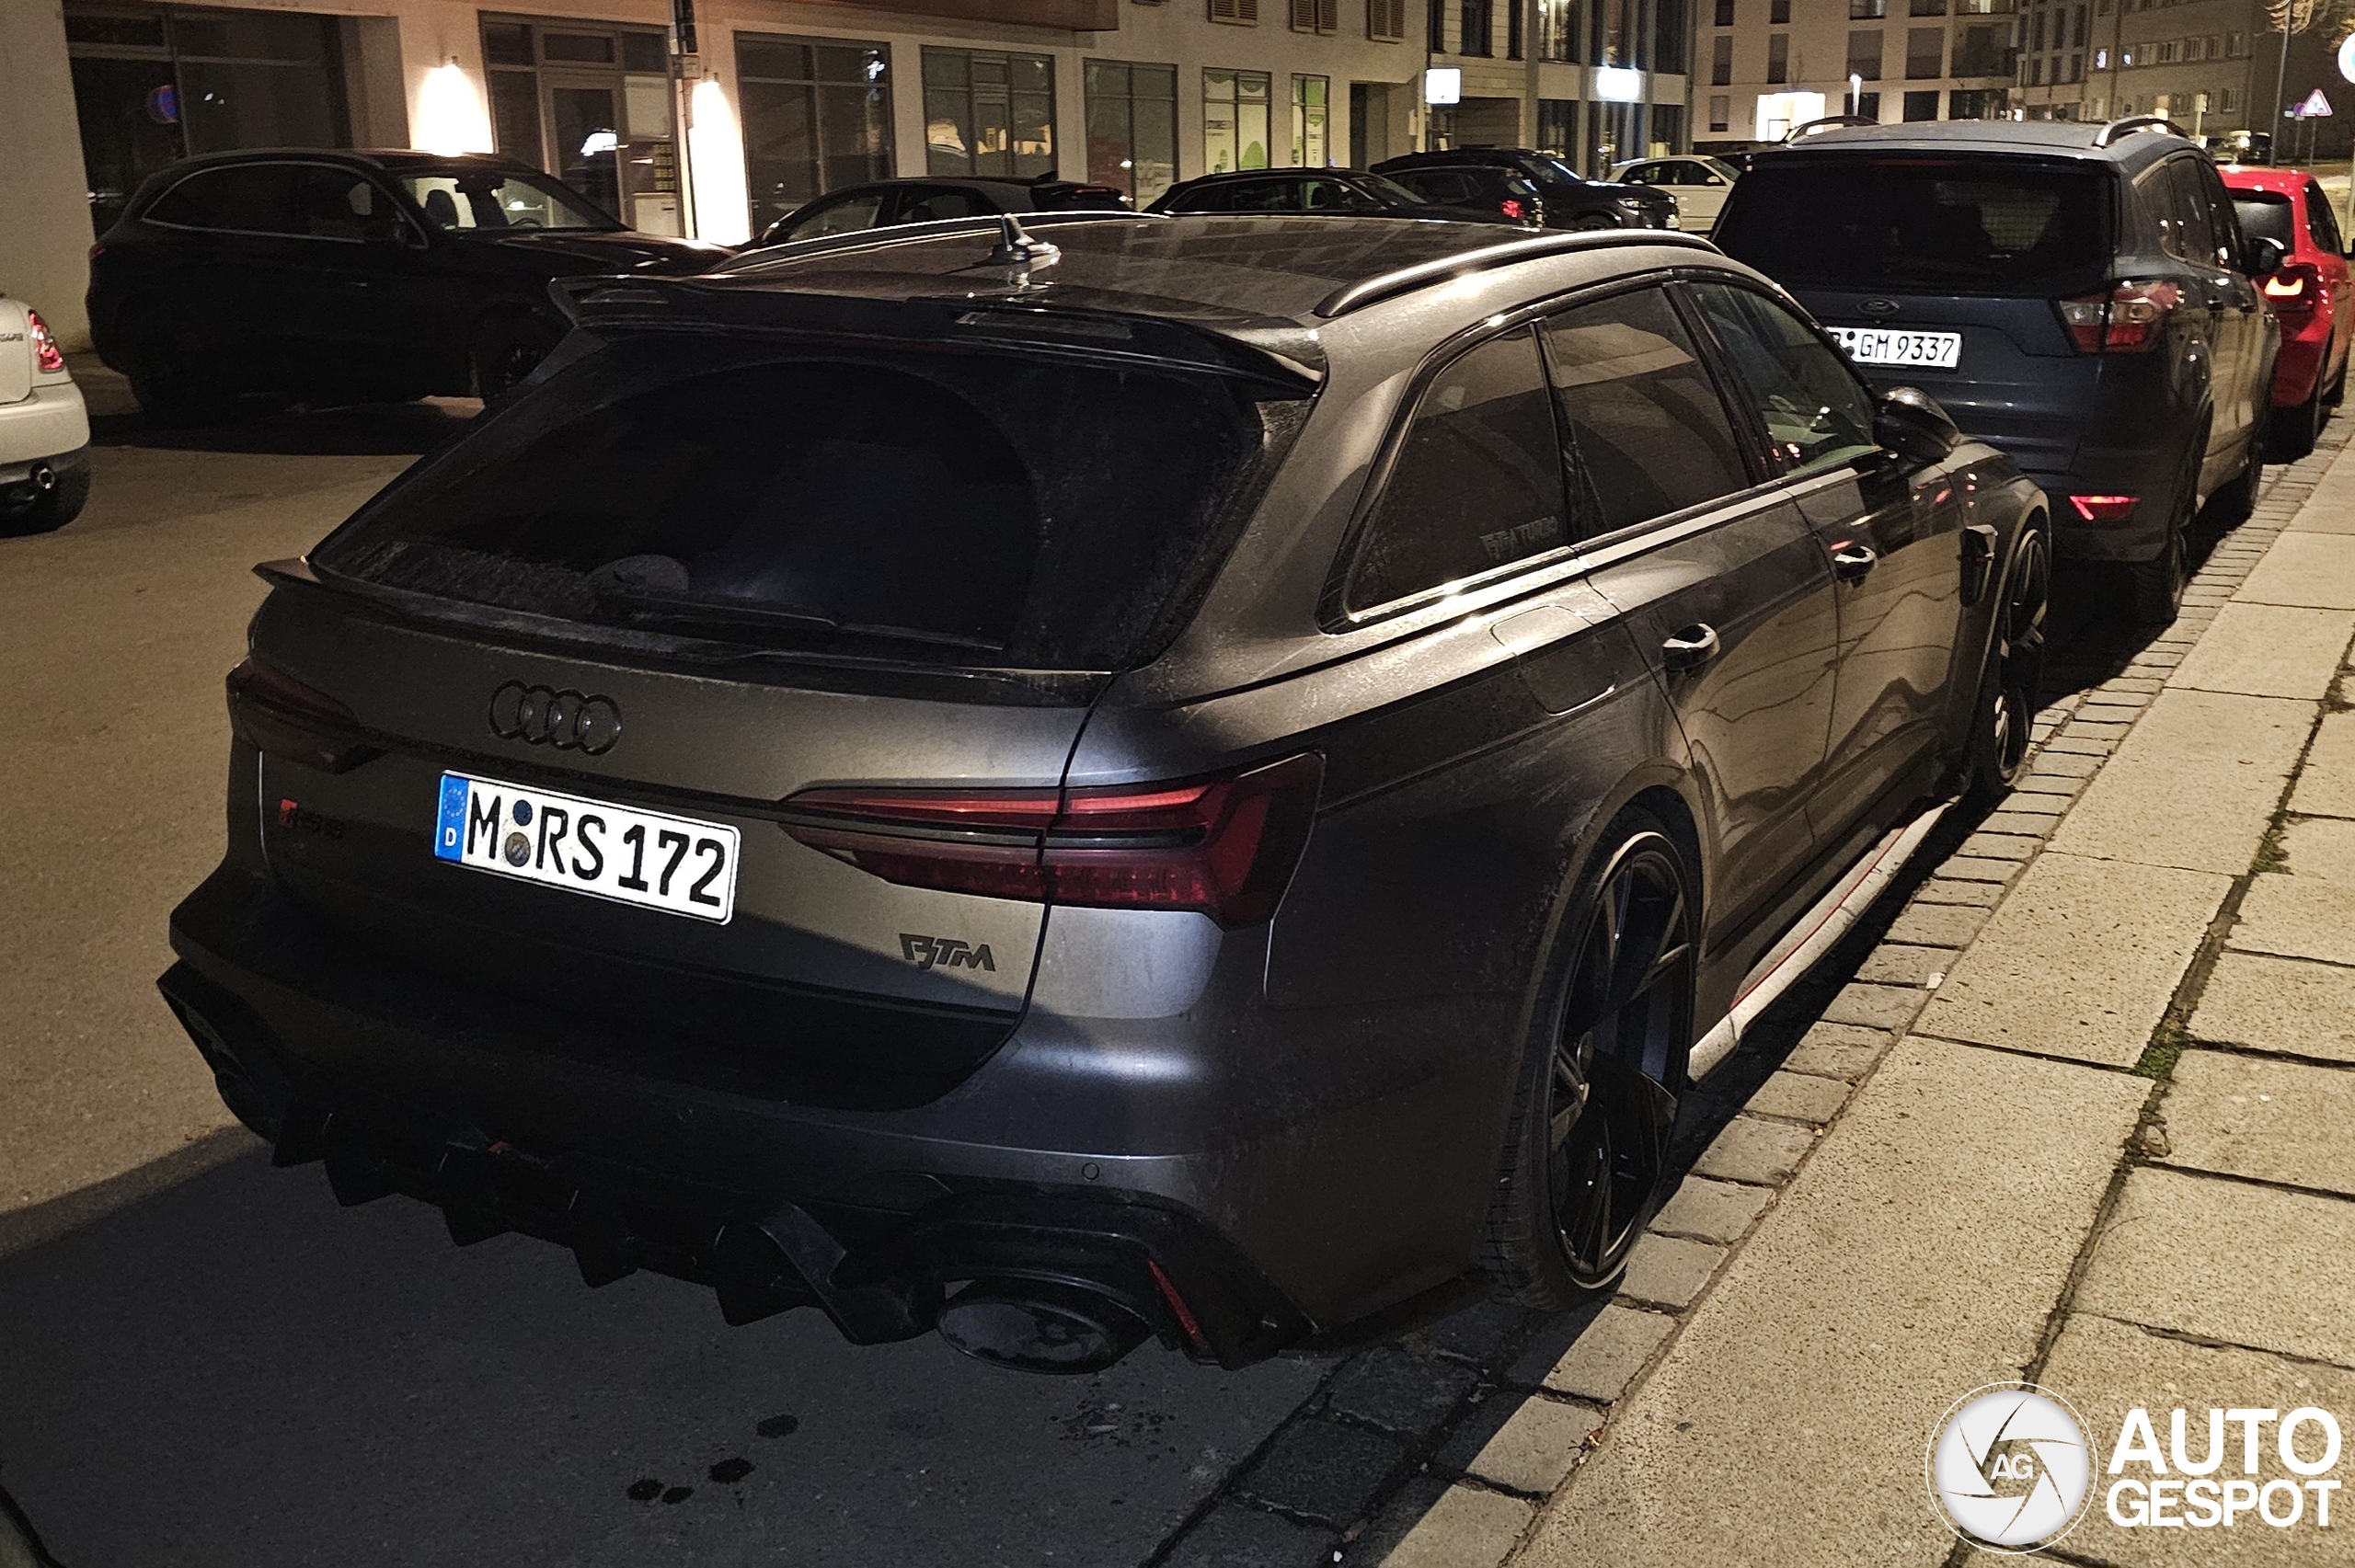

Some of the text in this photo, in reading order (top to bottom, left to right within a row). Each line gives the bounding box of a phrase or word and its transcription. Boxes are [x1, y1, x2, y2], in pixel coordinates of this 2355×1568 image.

[1859, 334, 1891, 360] GM
[1897, 336, 1956, 361] 9337
[444, 827, 457, 847] D
[466, 792, 726, 908] M RS 172
